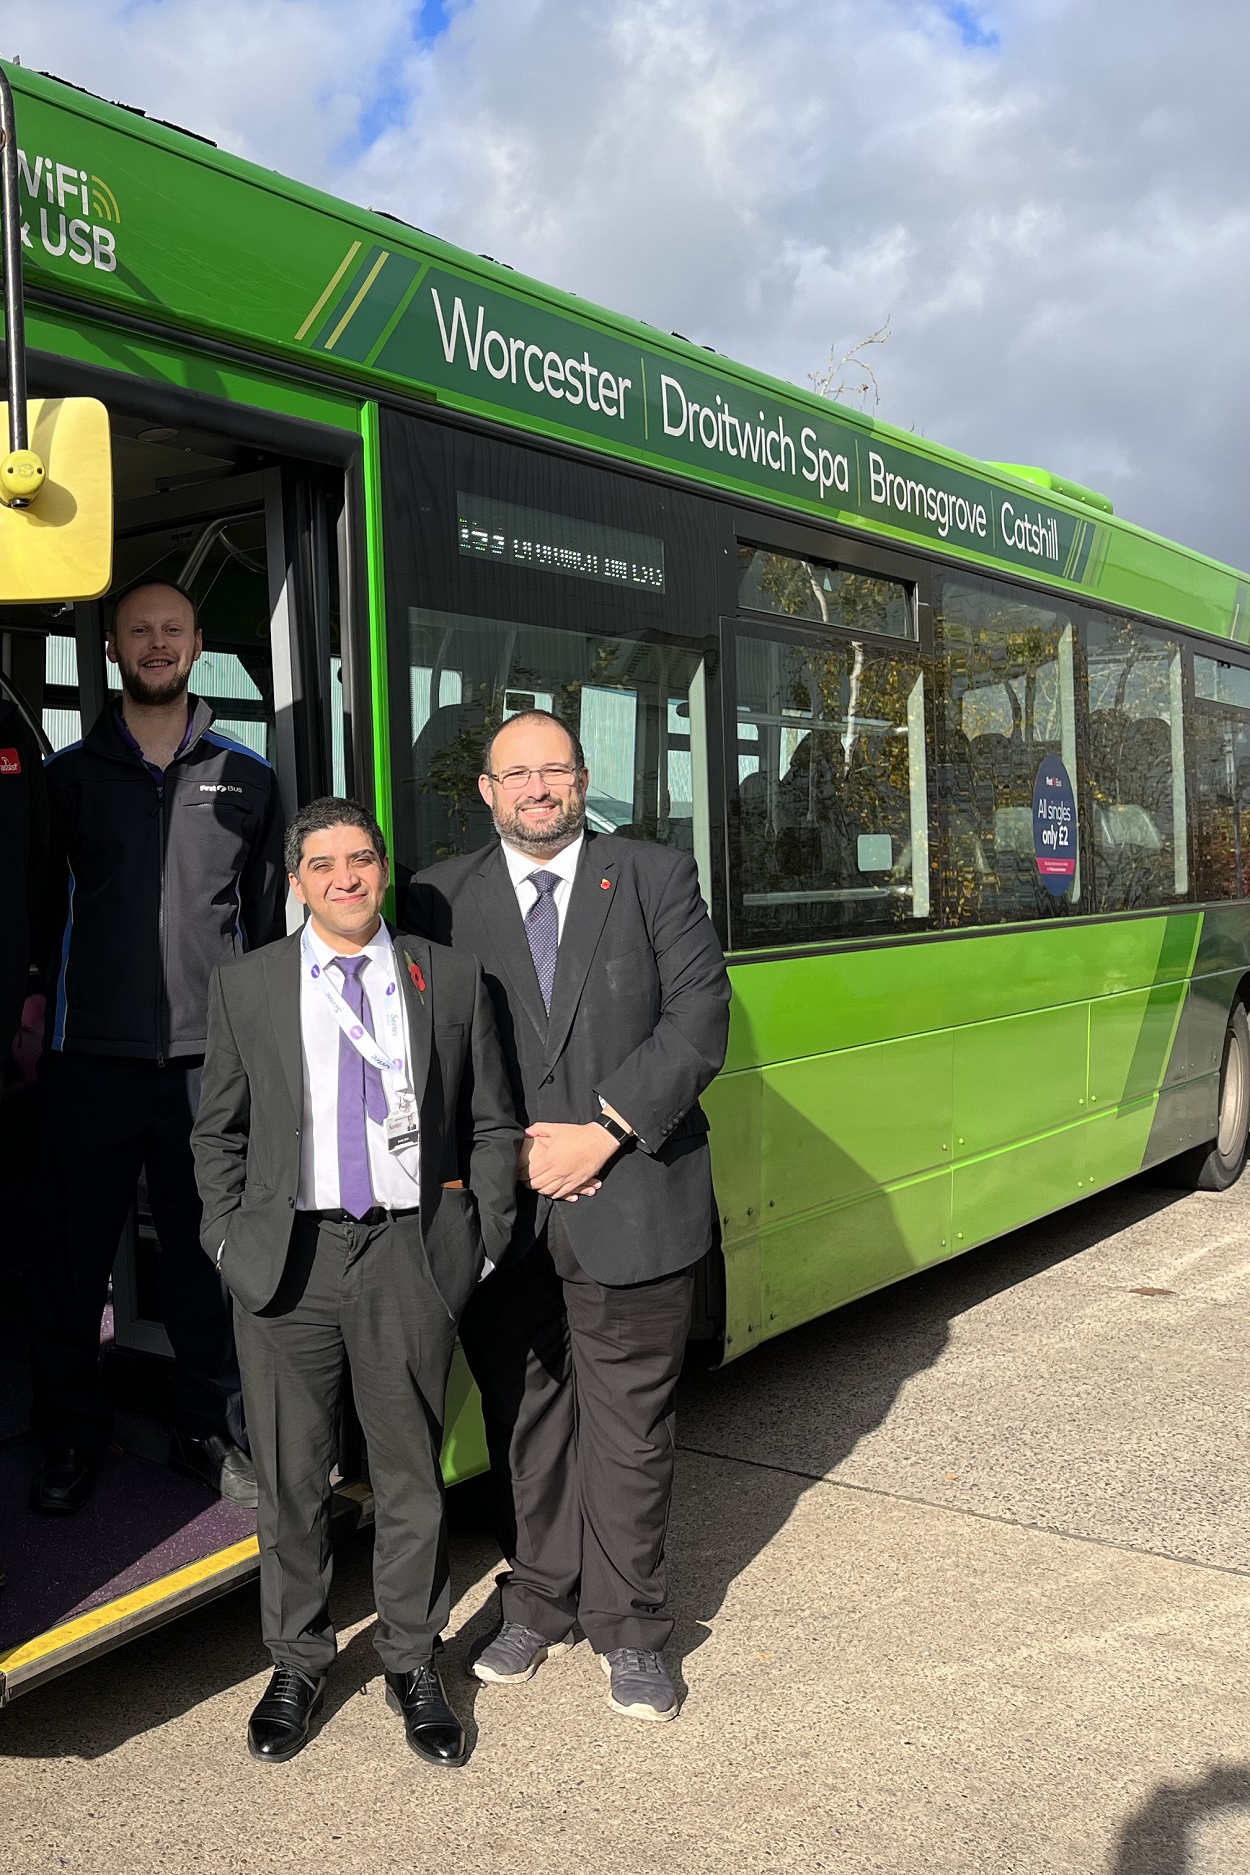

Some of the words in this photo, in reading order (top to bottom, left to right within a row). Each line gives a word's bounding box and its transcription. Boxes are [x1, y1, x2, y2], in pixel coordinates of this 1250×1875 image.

[40, 207, 117, 272] USB
[431, 287, 631, 420] Worcester
[661, 373, 796, 476] Droitwich
[801, 427, 849, 499] Spa
[869, 451, 987, 538] Bromsgrove
[1001, 501, 1059, 561] Catshill
[227, 785, 243, 793] Bus
[1037, 798, 1047, 819] All
[1048, 800, 1071, 826] singles
[1042, 824, 1058, 850] only
[1059, 825, 1069, 846] £2
